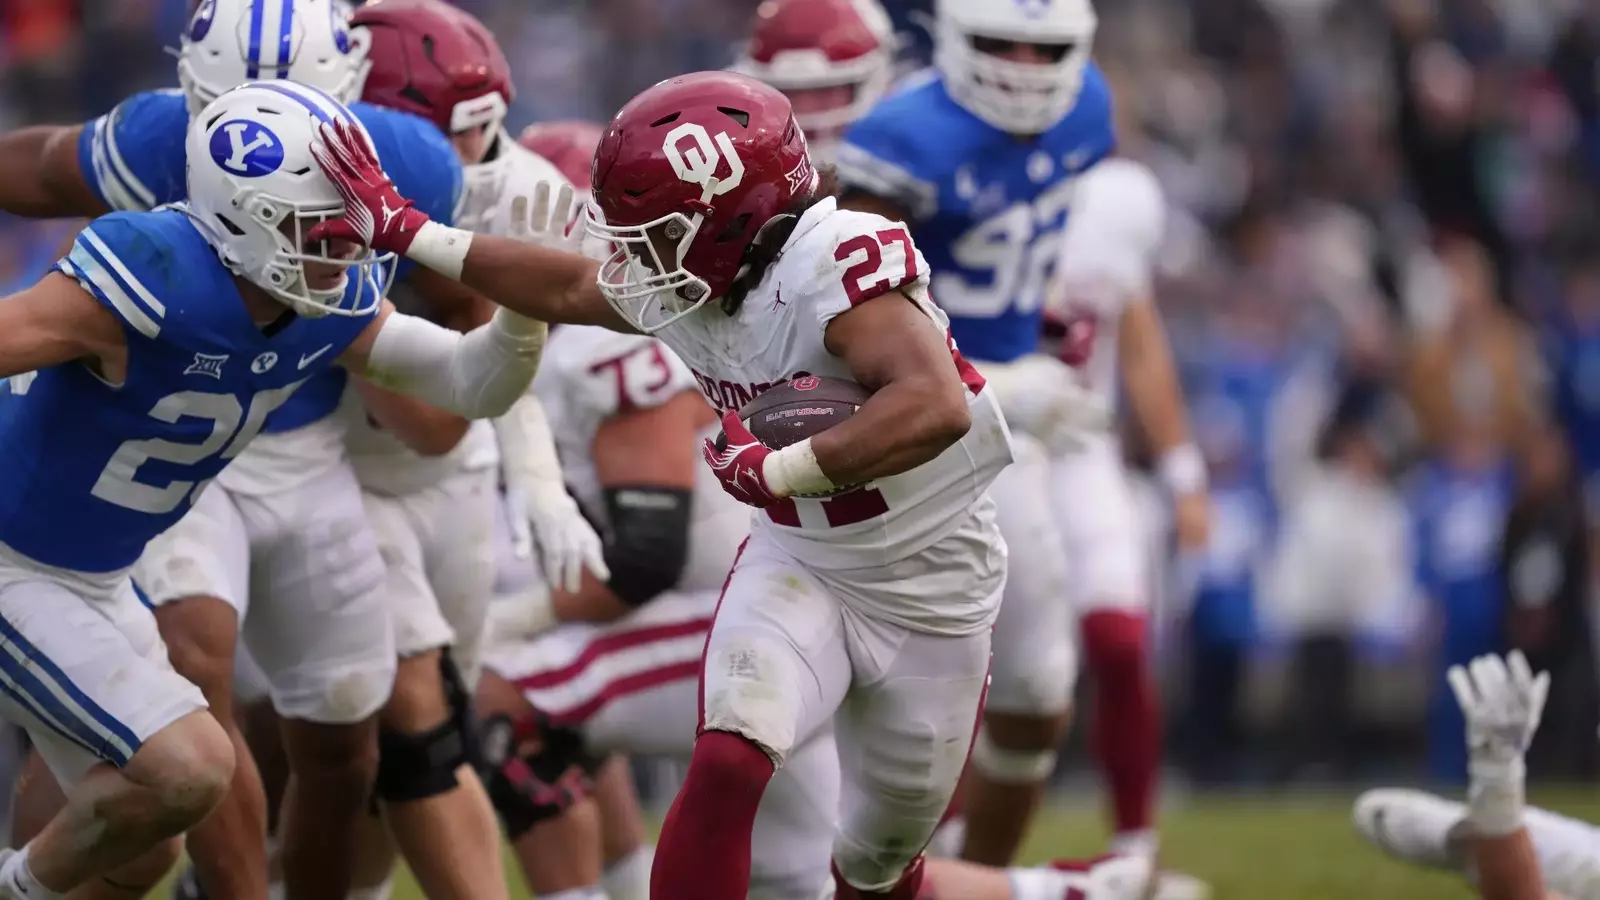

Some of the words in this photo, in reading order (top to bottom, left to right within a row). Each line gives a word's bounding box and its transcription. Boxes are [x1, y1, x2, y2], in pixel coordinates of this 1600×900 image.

[223, 122, 274, 172] Y
[662, 122, 745, 196] OU
[834, 228, 919, 307] 27
[588, 339, 671, 414] 73
